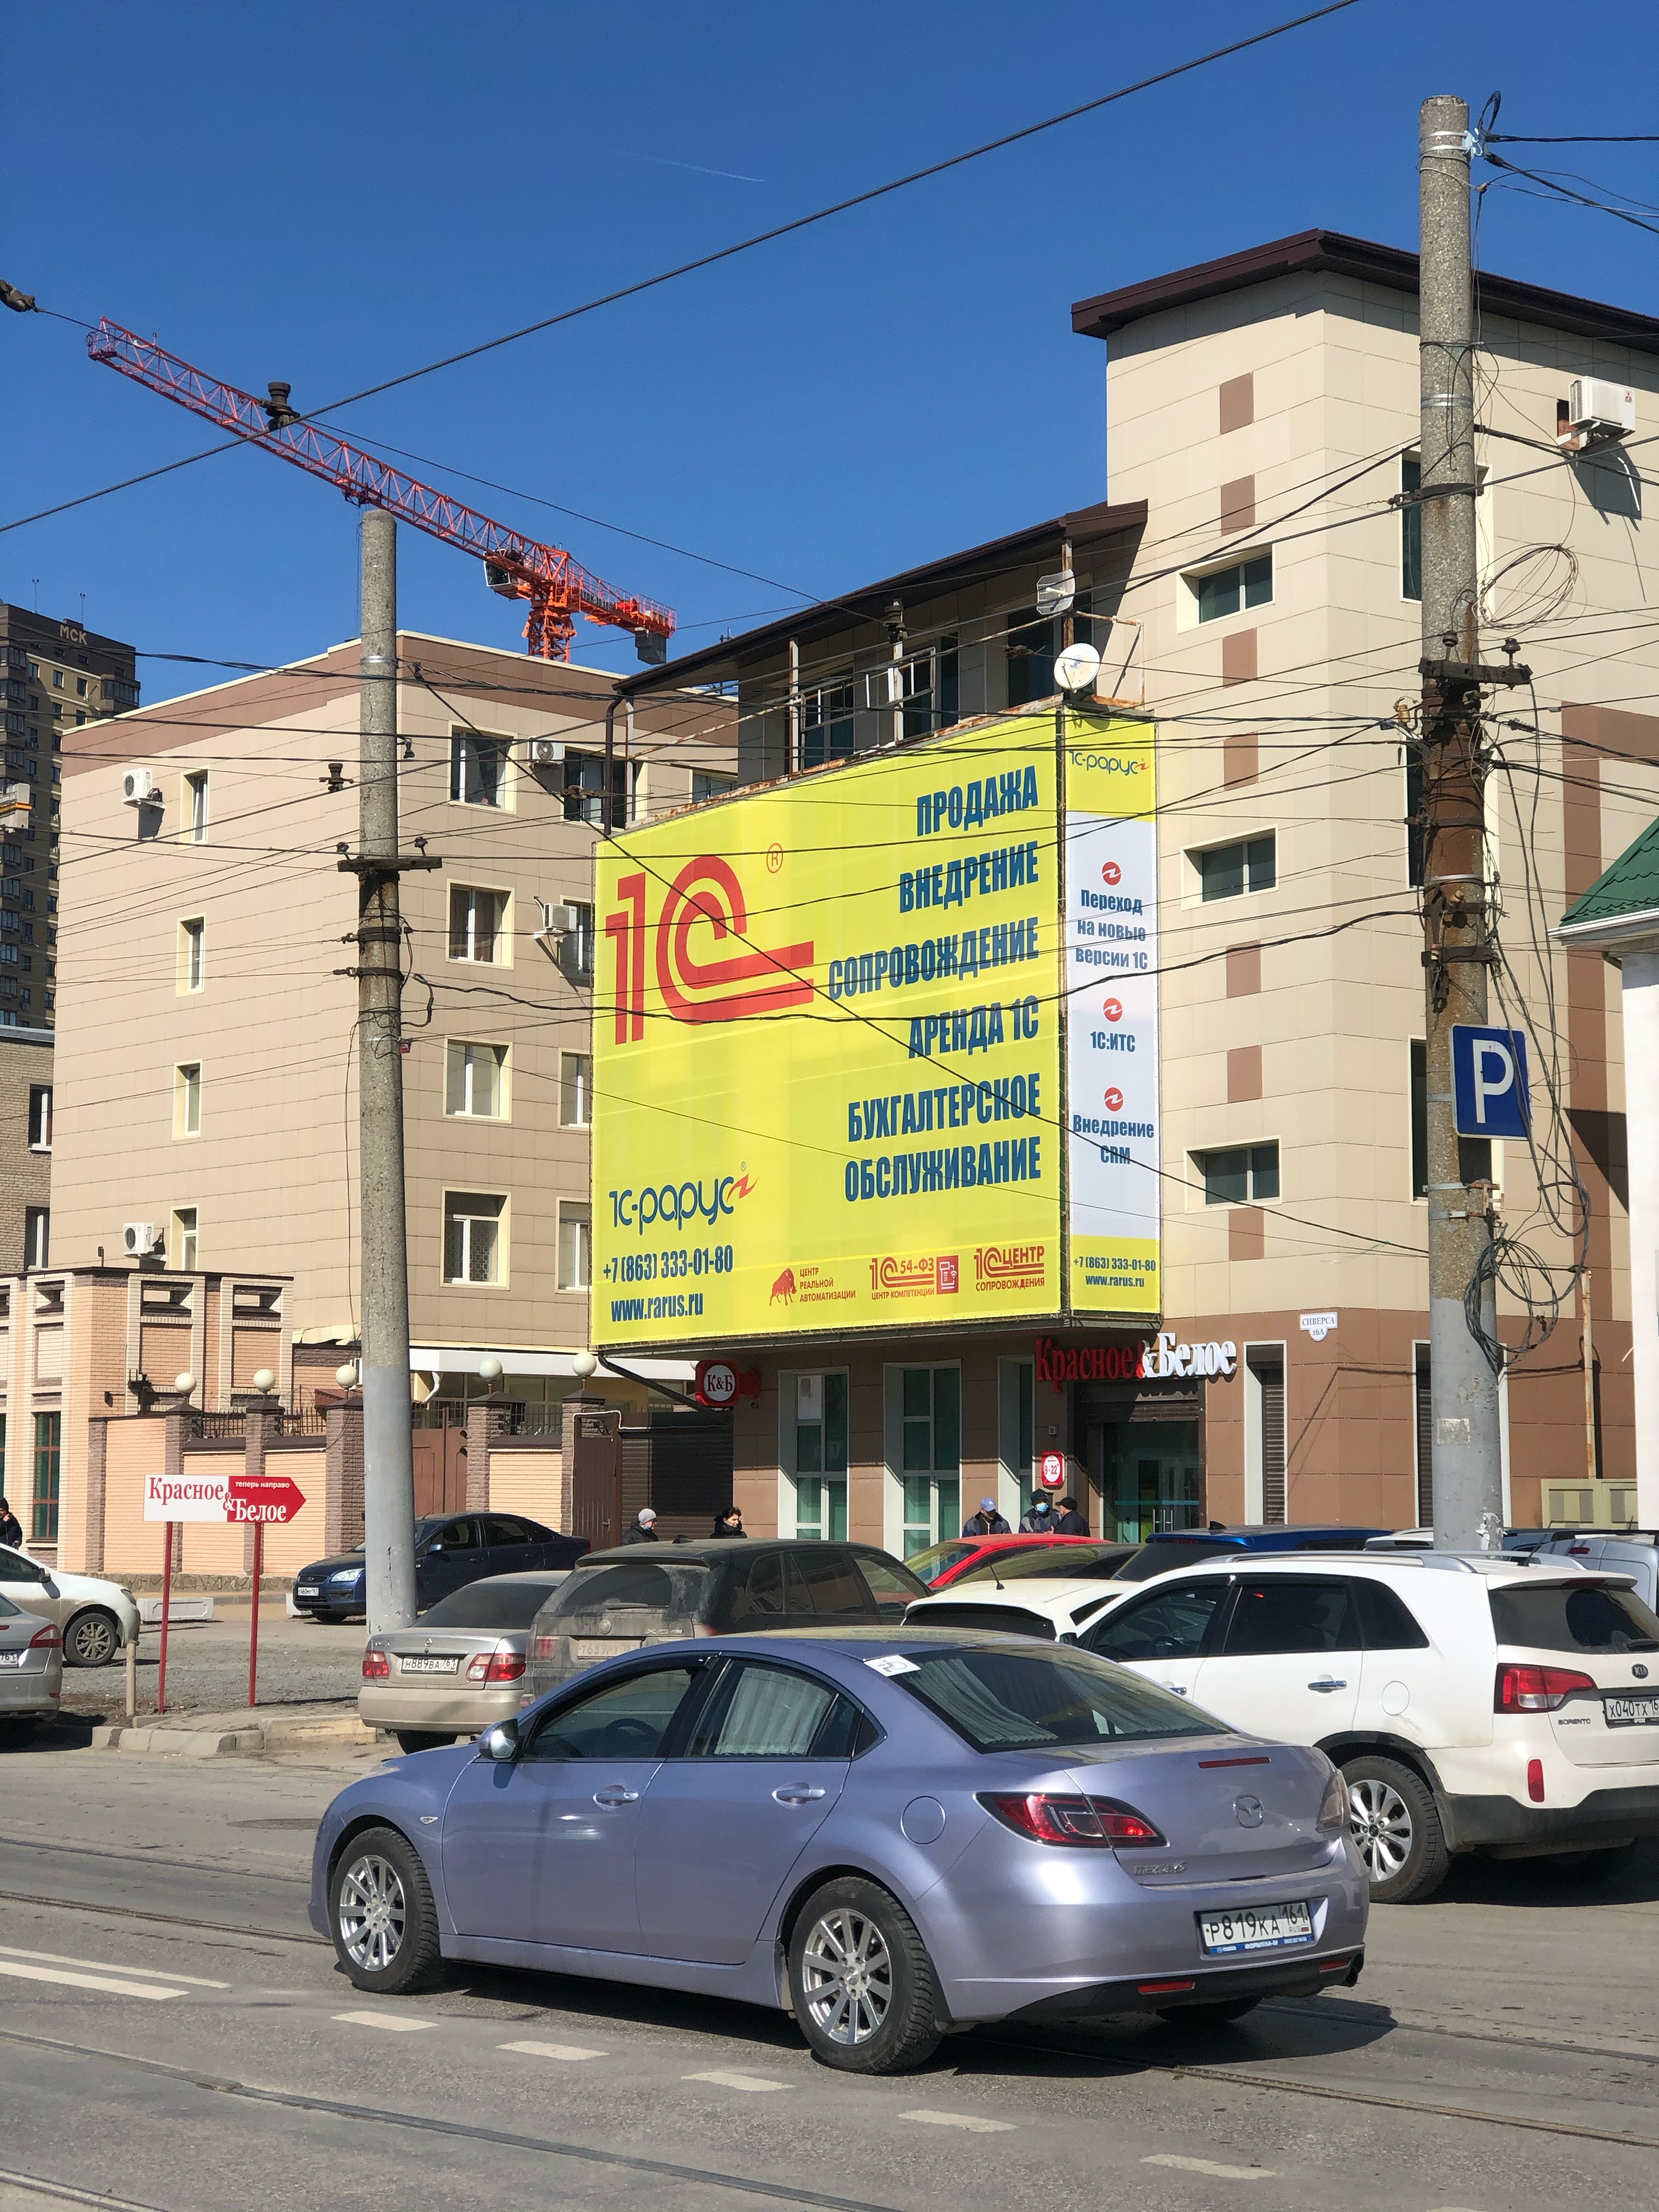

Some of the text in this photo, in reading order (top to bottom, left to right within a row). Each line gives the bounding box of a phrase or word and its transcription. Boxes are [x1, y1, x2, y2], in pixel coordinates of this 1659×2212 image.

[60, 624, 88, 646] МСК
[917, 765, 1039, 837] ПРОДАЖА
[900, 841, 1039, 913] ВНЕДРЕНИЕ
[1081, 889, 1143, 916] Переход
[1077, 919, 1146, 941] на новые
[830, 917, 1039, 1000] СОПРОВОЖДЕНИЕ
[909, 1000, 1005, 1059] АРЕНДА
[1090, 1031, 1136, 1053] 1С:ИТС
[848, 1073, 1041, 1142] БУХГАЛТЕРСКОЕ
[1073, 1114, 1154, 1138] Внедрение
[845, 1136, 1041, 1202] ОБСЛУЖИВАНИЕ
[603, 1245, 733, 1283] +7 (863) 333-01-80
[1003, 1245, 1045, 1268] ЦЕНТР
[1074, 1256, 1156, 1271] +7 (863) 333-01-80
[800, 1267, 819, 1277] ЦЕНТР
[800, 1277, 833, 1289] РЕАЛЬНОЙ
[1086, 1276, 1144, 1288] www.rarus.ru
[871, 1288, 934, 1301] ЦЕНТР КОМПЕТЕНЦИИ
[975, 1277, 1045, 1291] СОПРОВОЖДЕНИЯ
[800, 1290, 856, 1302] АВТОМАТИЗАЦИИ
[611, 1293, 703, 1322] www.rarus.ru
[1302, 1317, 1335, 1326] СИВЕРСА
[149, 1477, 224, 1505] Красное
[233, 1498, 287, 1522] Белое
[1282, 1904, 1306, 1926] 161
